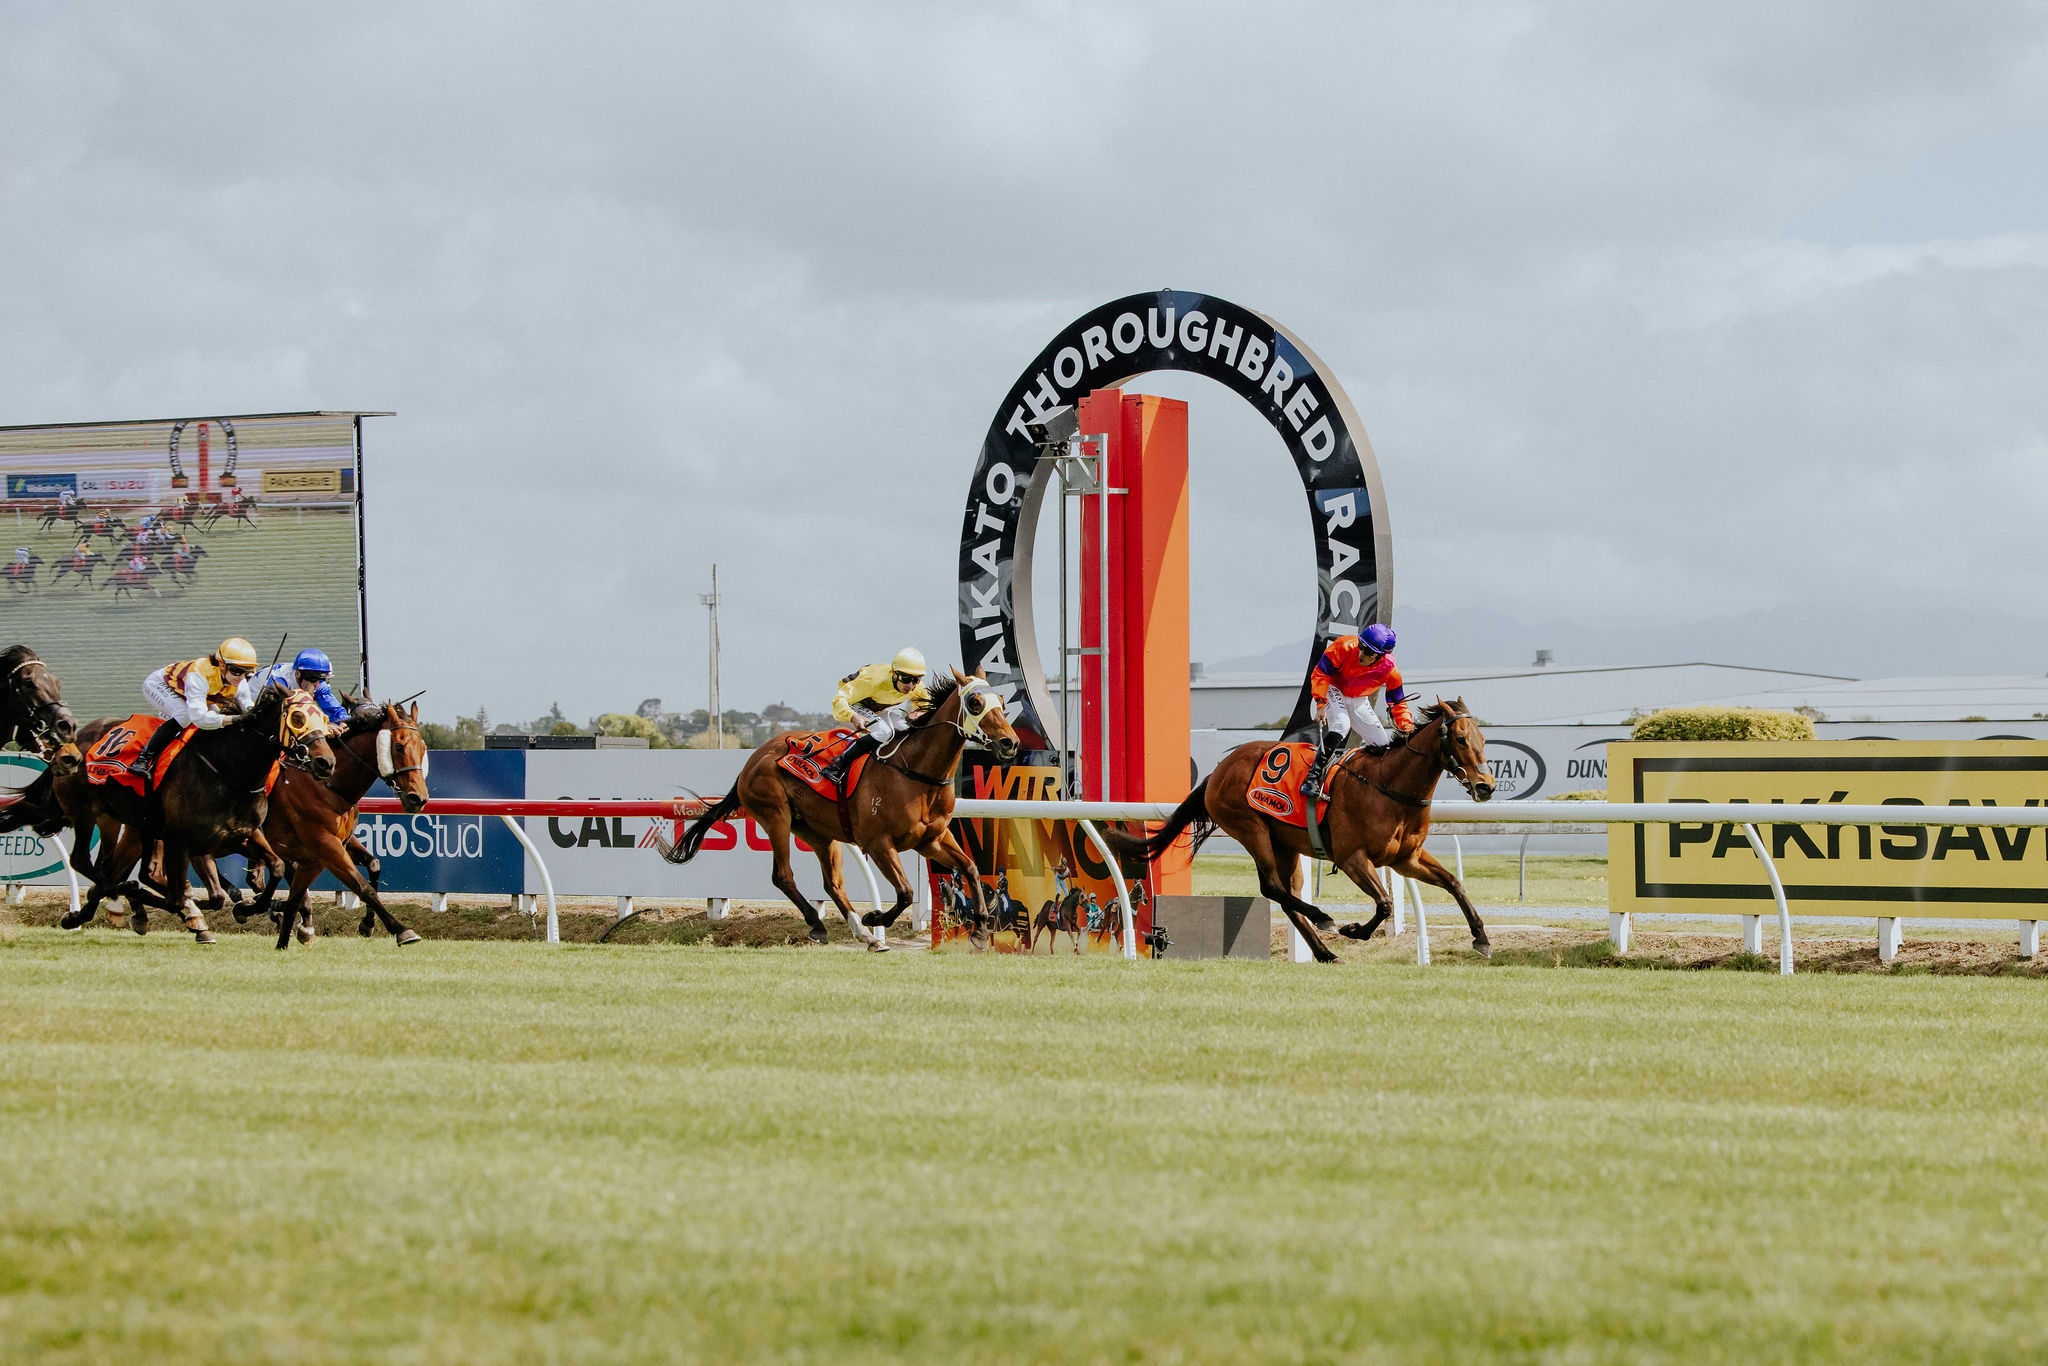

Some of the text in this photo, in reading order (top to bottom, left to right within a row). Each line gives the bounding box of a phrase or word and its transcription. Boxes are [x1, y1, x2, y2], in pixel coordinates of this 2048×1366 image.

[1005, 307, 1336, 462] THOROUGHBRED
[1323, 491, 1361, 648] RACI
[787, 755, 816, 780] LIVAMOL
[1262, 747, 1292, 785] 9
[973, 765, 1062, 800] WTR
[1494, 780, 1517, 792] EEDS
[871, 797, 882, 806] 12
[871, 807, 878, 816] 9
[1253, 790, 1286, 813] LIVAMOL
[548, 796, 636, 849] CAL
[1668, 790, 2048, 861] PAK'nSAV
